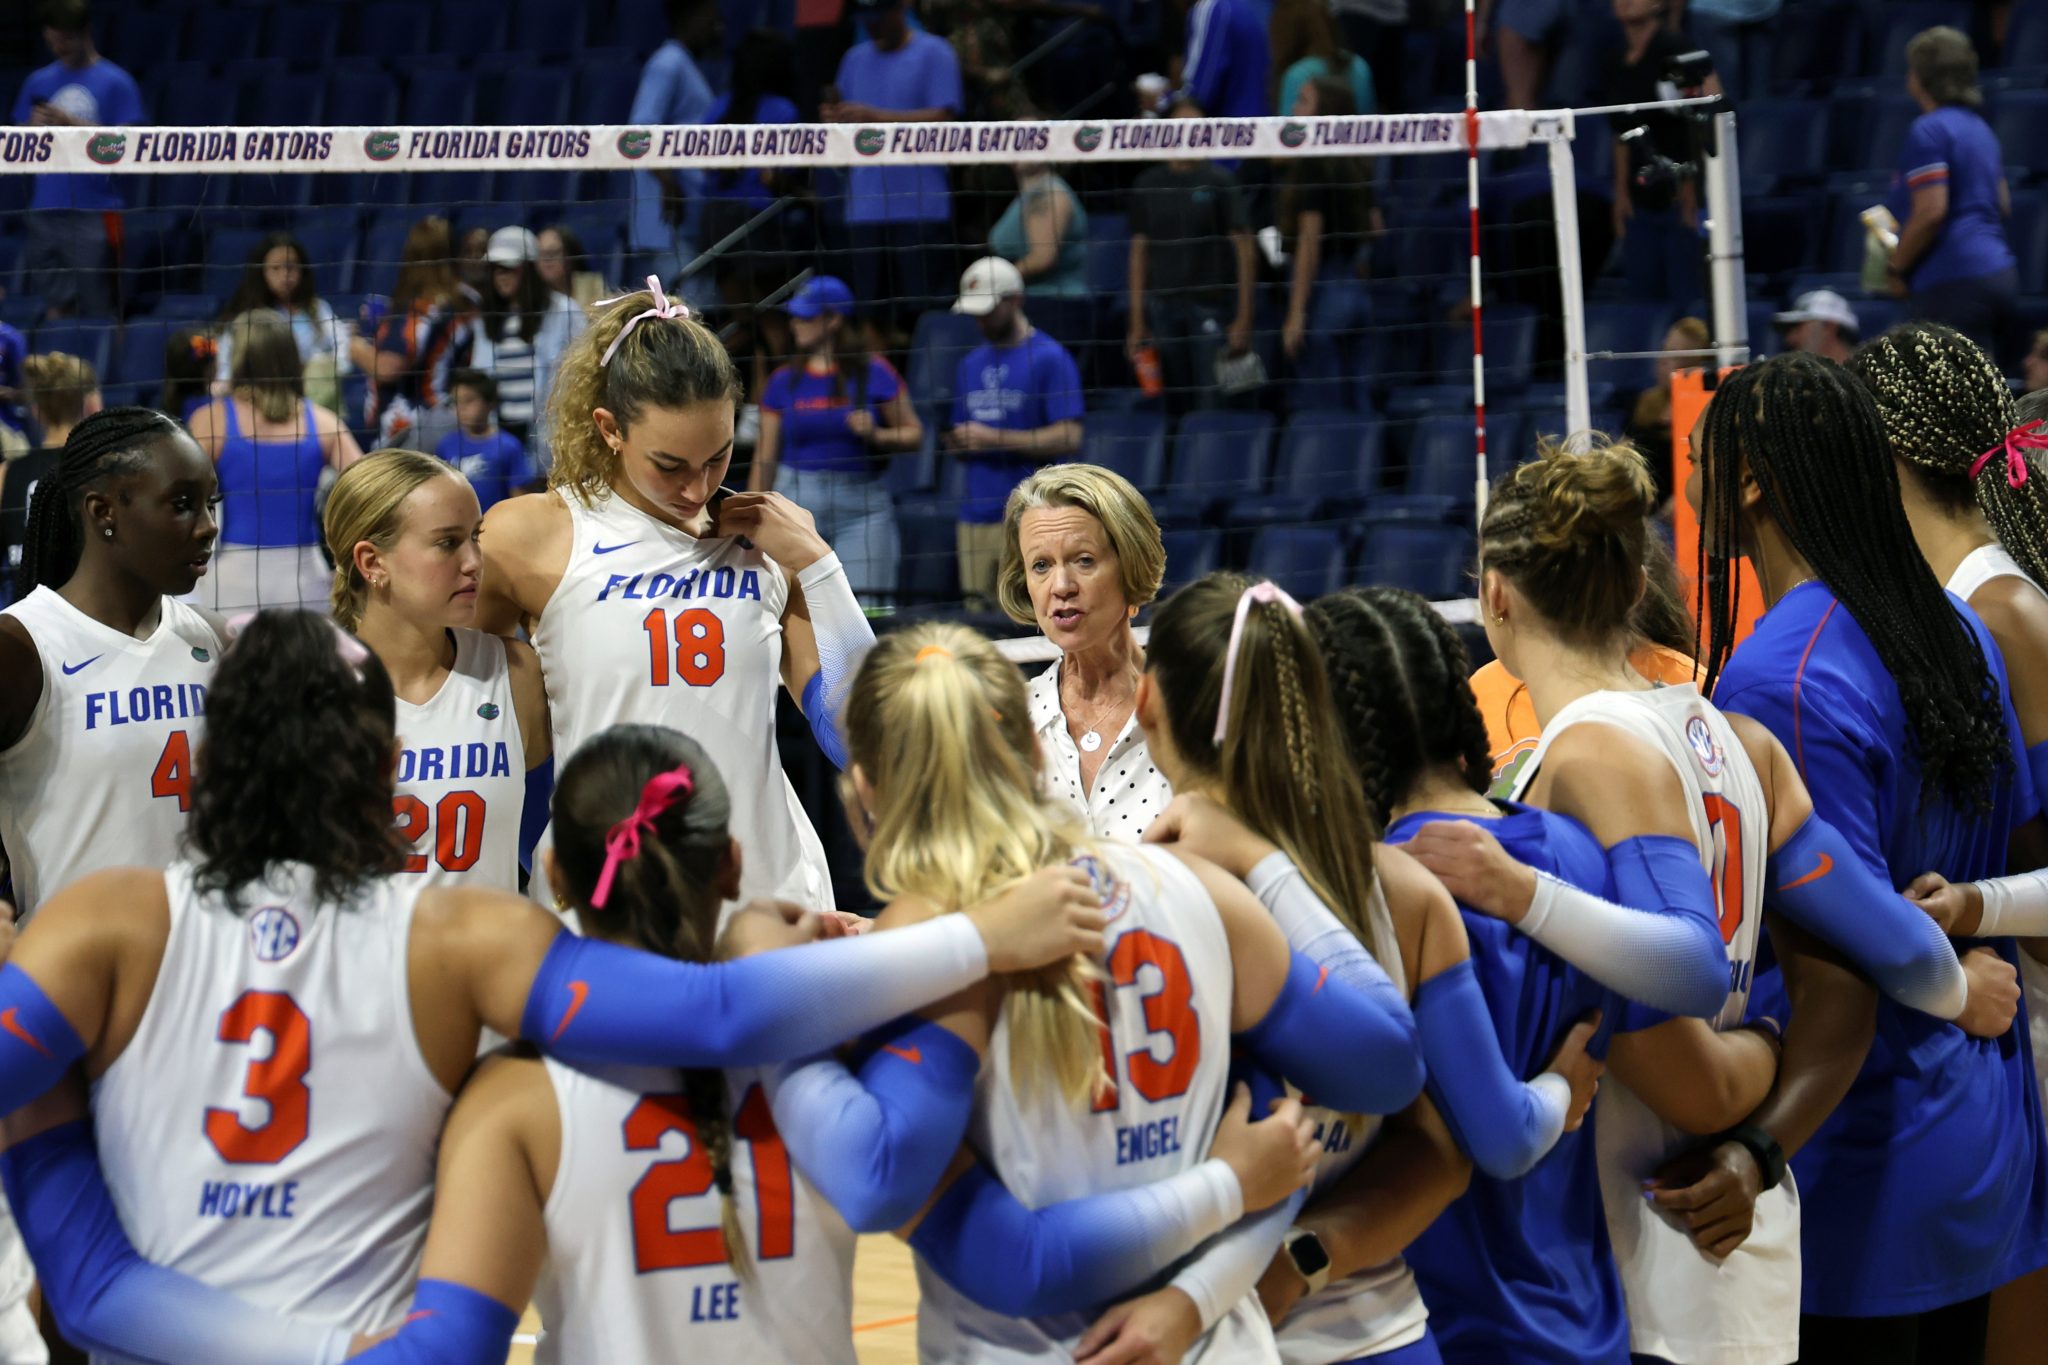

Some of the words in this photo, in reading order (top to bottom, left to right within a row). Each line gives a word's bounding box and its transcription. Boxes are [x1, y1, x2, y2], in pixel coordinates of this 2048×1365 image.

[134, 132, 236, 162] FLORIDA
[243, 131, 333, 161] GATORS
[407, 131, 500, 159] FLORIDA
[505, 130, 591, 158] GATORS
[658, 129, 746, 156] FLORIDA
[751, 128, 828, 155] GATORS
[890, 127, 972, 152] FLORIDA
[977, 126, 1049, 151] GATORS
[1110, 124, 1183, 148] FLORIDA
[1188, 122, 1257, 147] GATORS
[1313, 120, 1384, 145] FLORIDA
[1389, 118, 1453, 142] GATORS
[597, 566, 761, 601] FLORIDA
[643, 607, 725, 687] 18
[151, 730, 191, 812] 4
[393, 790, 487, 873] 20
[202, 988, 311, 1164] 3
[1116, 1115, 1181, 1165] ENGEL
[198, 1181, 299, 1218] HOYLE
[623, 1080, 795, 1275] 21
[690, 1282, 740, 1323] LEE
